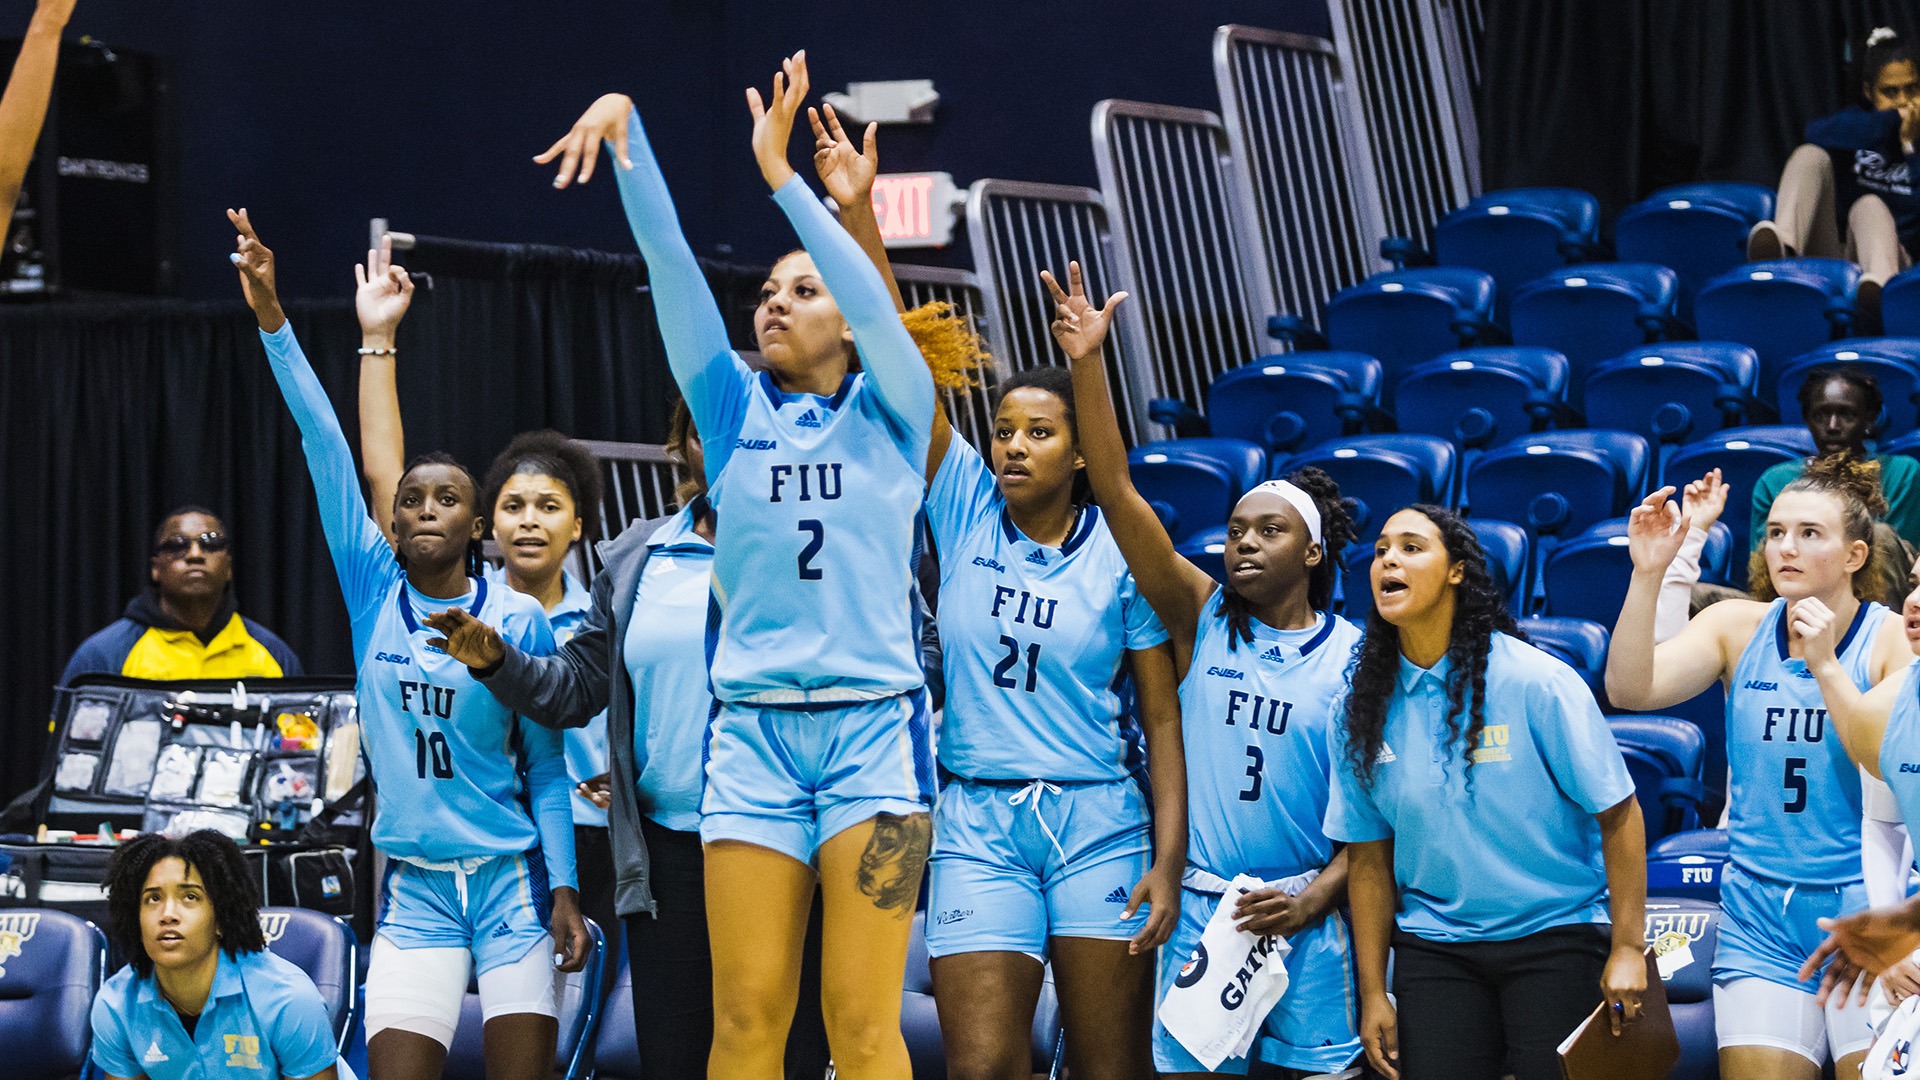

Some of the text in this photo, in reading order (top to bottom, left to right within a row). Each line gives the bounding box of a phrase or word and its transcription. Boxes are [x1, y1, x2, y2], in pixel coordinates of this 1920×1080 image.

[769, 463, 843, 503] FIU
[797, 519, 825, 581] 2
[990, 584, 1059, 630] FIU
[993, 634, 1042, 693] 21
[399, 680, 456, 720] FIU
[1225, 689, 1294, 736] FIU
[1483, 724, 1509, 747] IU
[1762, 707, 1828, 743] FIU
[415, 727, 454, 779] 10
[1239, 744, 1265, 802] 3
[1783, 757, 1808, 814] 5
[1682, 867, 1714, 884] FIU
[1643, 913, 1711, 943] FIU
[223, 1034, 260, 1055] FIU
